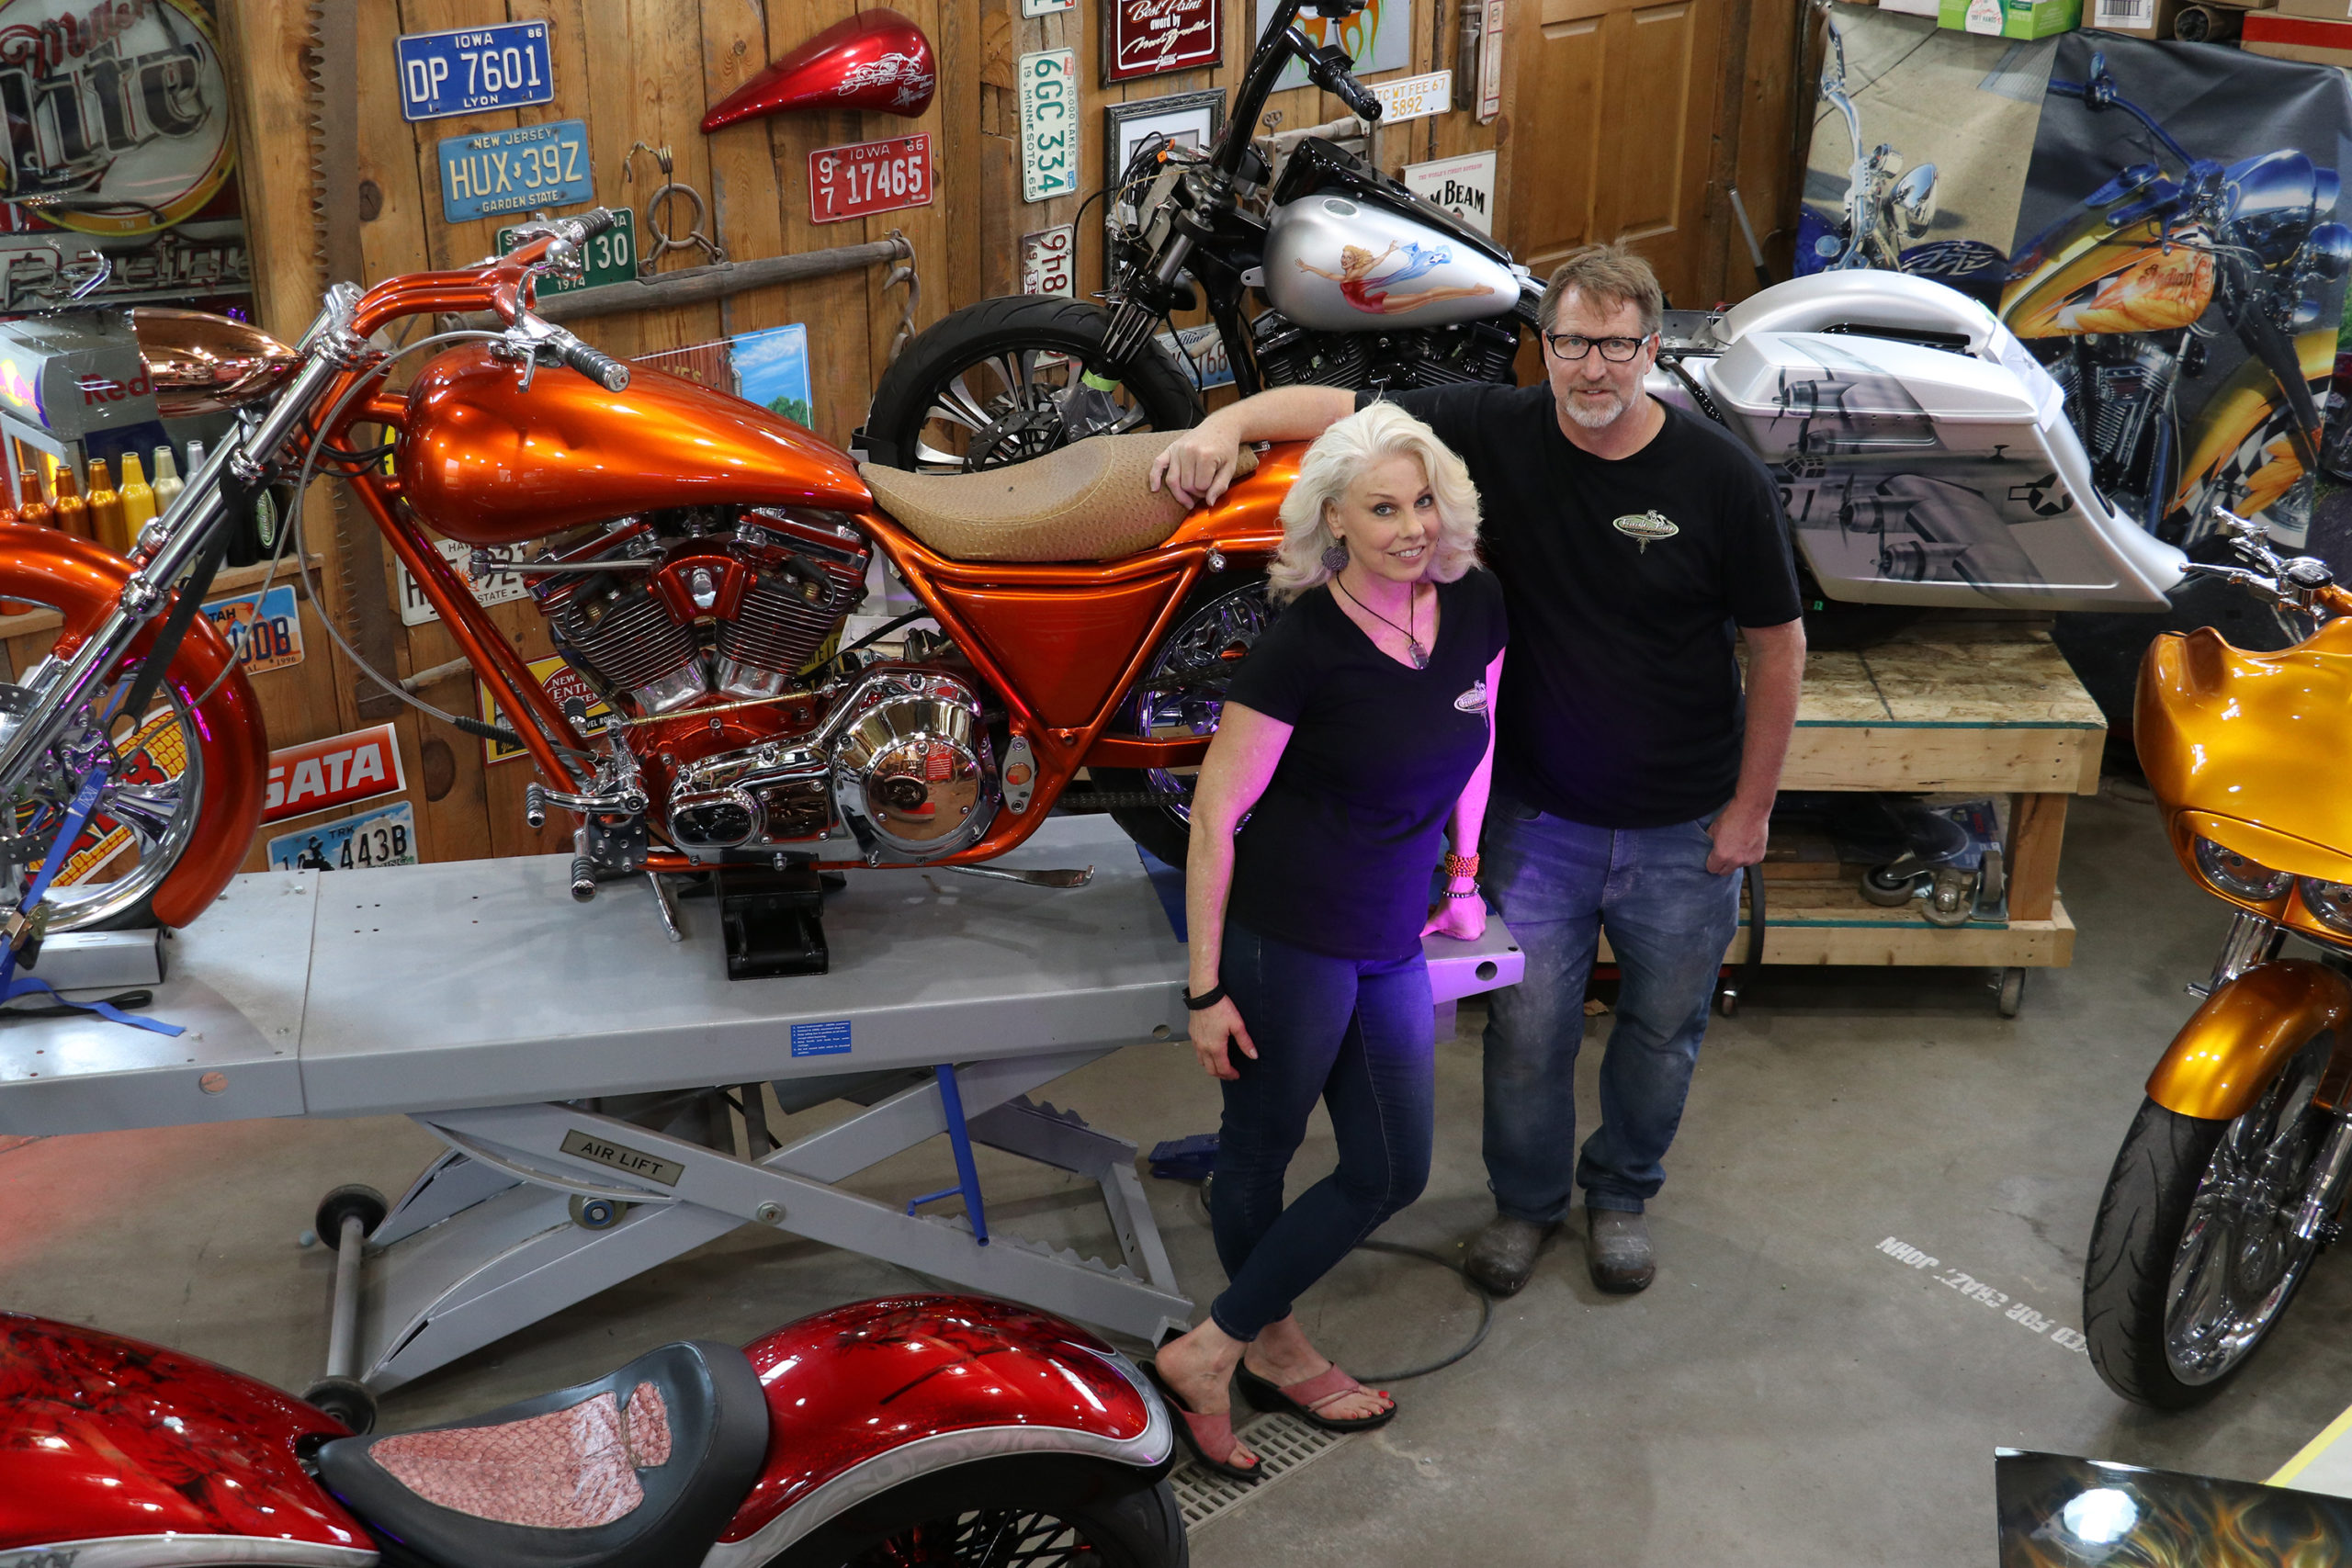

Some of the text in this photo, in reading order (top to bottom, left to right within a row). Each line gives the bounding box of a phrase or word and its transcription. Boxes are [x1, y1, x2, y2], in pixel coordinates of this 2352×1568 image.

[1127, 0, 1162, 21] Best
[1150, 14, 1182, 30] award by
[455, 28, 543, 49] IOWA 86
[407, 45, 541, 103] DP 7601
[1408, 80, 1430, 96] FEE
[1432, 77, 1446, 91] 67
[463, 95, 499, 108] LYON
[1391, 96, 1423, 118] 5892
[1024, 89, 1035, 168] MINNESOTA
[1035, 59, 1065, 193] 6GC 334
[473, 129, 552, 150] NEW JERSEY
[850, 139, 924, 161] IOWA 66
[449, 141, 583, 201] HUX 39Z
[846, 155, 922, 205] 17465
[481, 190, 560, 213] GARDEN STATE
[119, 220, 135, 229] TM
[81, 365, 151, 406] Red
[477, 589, 508, 603] STATE
[209, 607, 236, 623] TAH
[552, 673, 576, 688] NEW
[264, 743, 385, 810] SATA
[328, 825, 355, 840] TRK
[340, 824, 407, 870] 443B
[581, 1142, 663, 1175] AIR LIFT
[1875, 1236, 1939, 1269] JOHN
[2005, 1303, 2056, 1333] FOR
